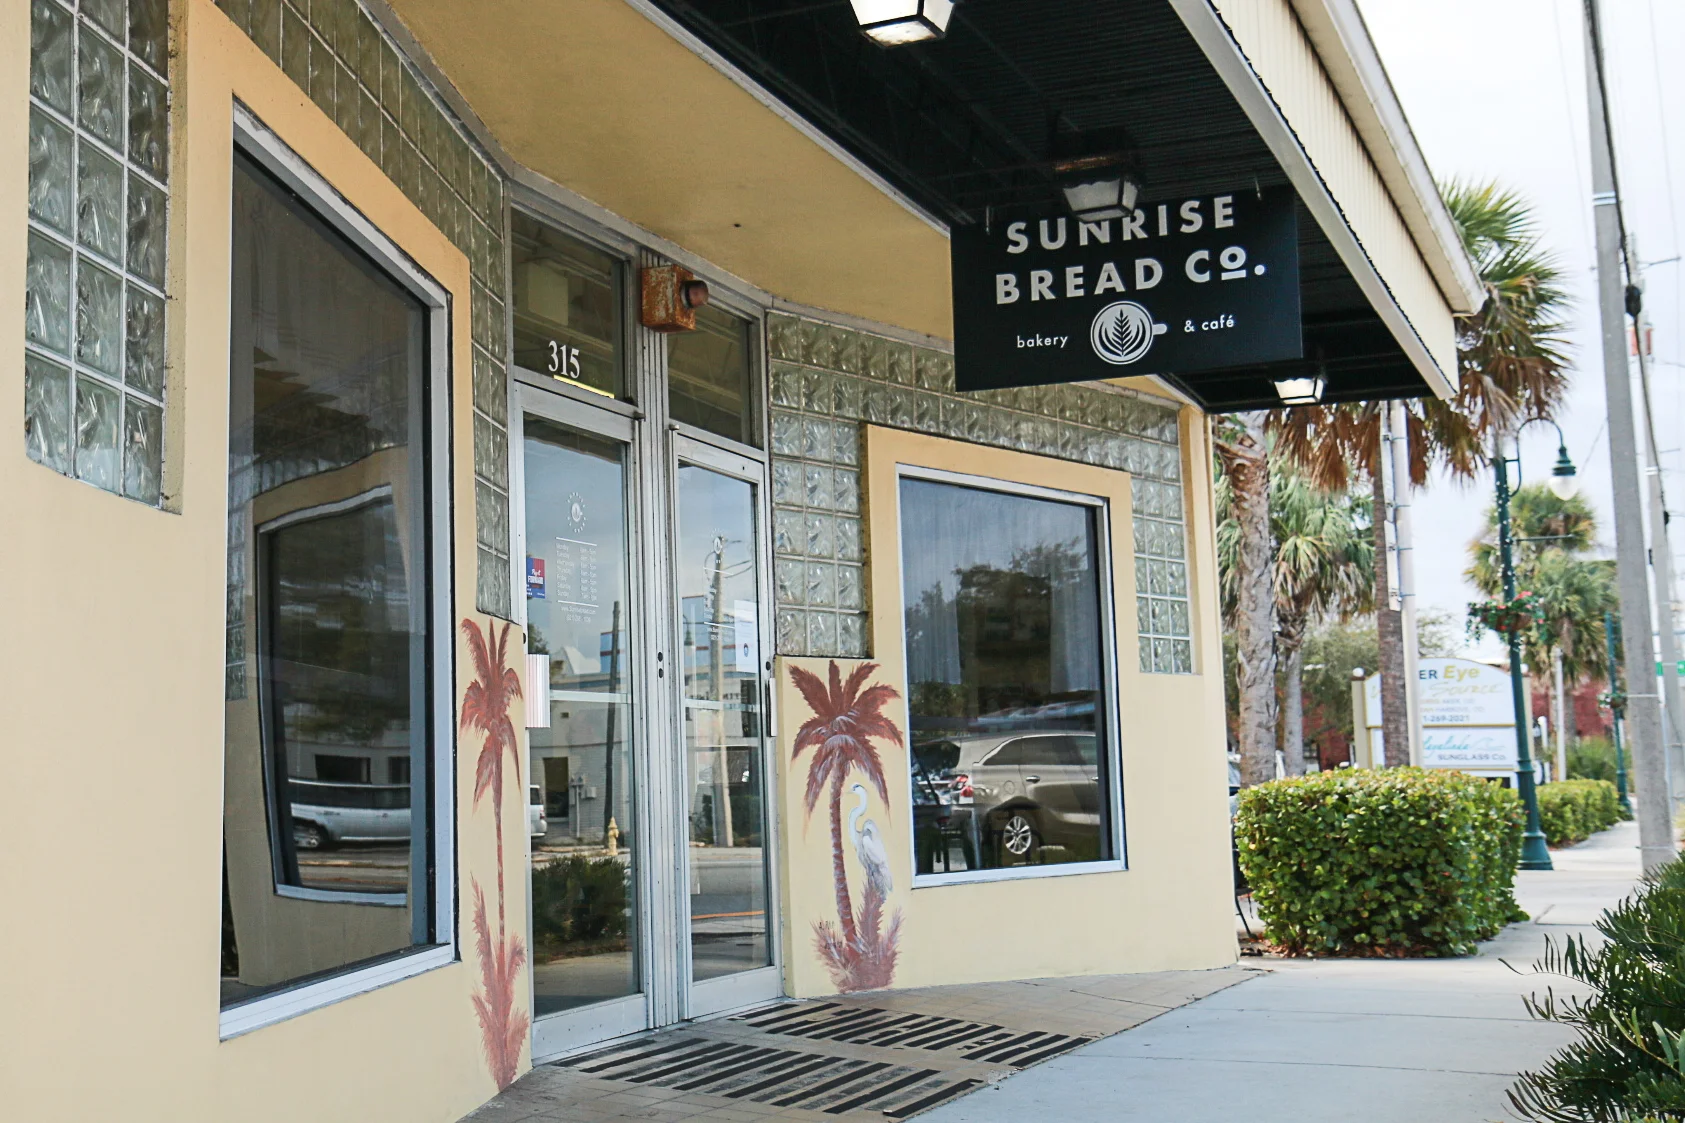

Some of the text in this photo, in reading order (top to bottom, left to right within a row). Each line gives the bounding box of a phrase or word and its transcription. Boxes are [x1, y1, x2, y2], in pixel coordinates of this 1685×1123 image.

[1006, 195, 1235, 255] SUNRISE
[996, 258, 1164, 305] BREAD
[1016, 314, 1236, 350] bakery & café
[548, 340, 581, 379] 315
[1418, 665, 1480, 682] ER Eye
[1437, 753, 1490, 761] SUNGLASS
